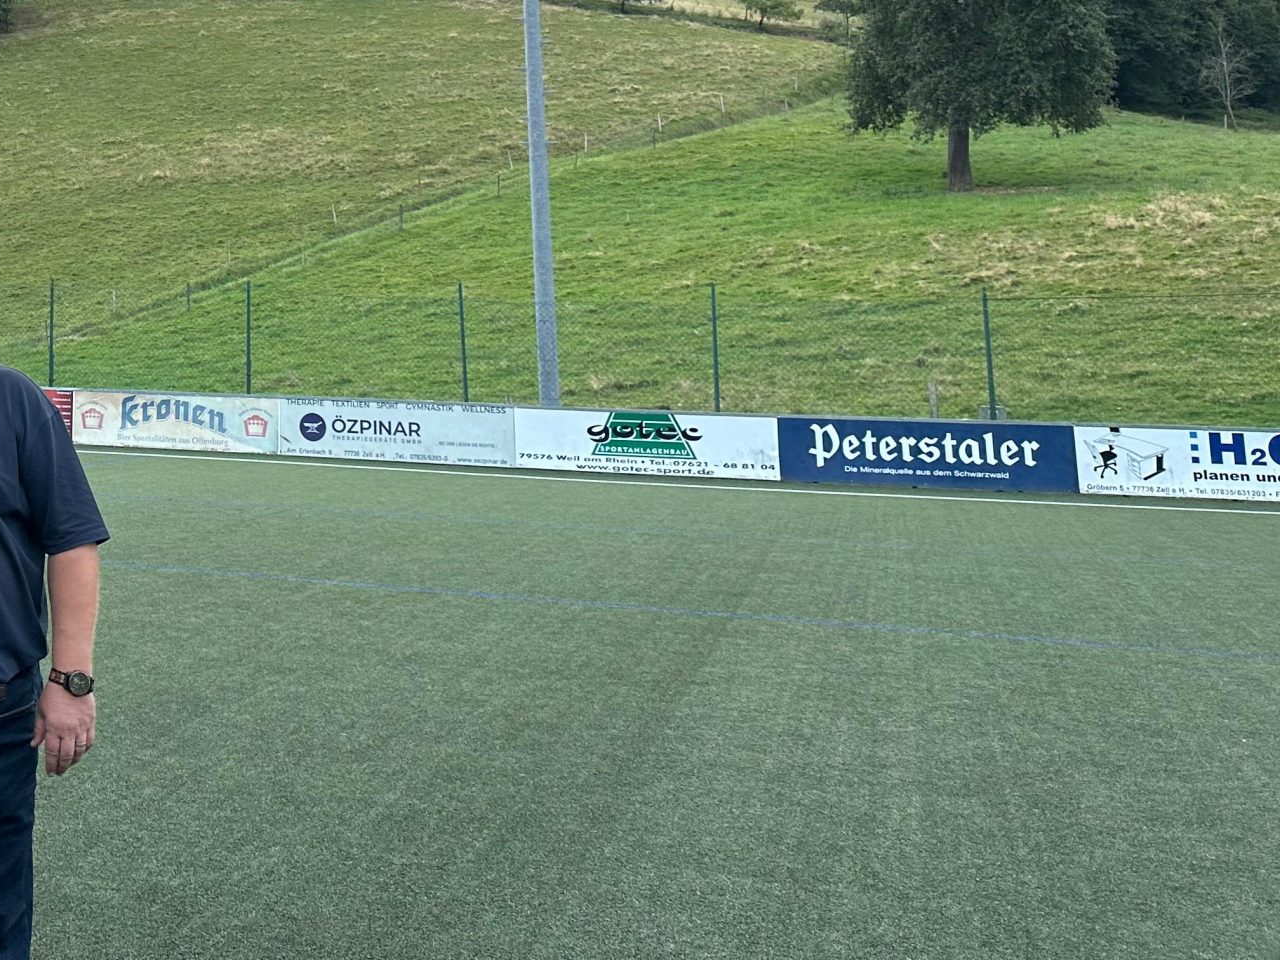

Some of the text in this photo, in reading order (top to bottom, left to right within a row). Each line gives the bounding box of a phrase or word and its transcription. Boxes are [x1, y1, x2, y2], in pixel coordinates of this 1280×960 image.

[286, 399, 325, 407] THERAPIE
[331, 400, 370, 408] TEXTILIEN
[405, 403, 454, 412] GYMNASTIK
[462, 405, 507, 414] WELLNESS
[331, 414, 421, 437] ÖZPINAR
[587, 420, 703, 443] gotec
[600, 445, 687, 455] SPORTANLAGENBAU
[808, 423, 1041, 468] Peterstaler
[576, 464, 715, 476] www.gotec-sport.de
[844, 465, 858, 473] Die
[859, 466, 914, 475] Mineralquelle
[933, 469, 952, 477] dem
[954, 469, 1010, 479] Schwarzwald
[1193, 470, 1250, 482] planen
[1086, 483, 1118, 492] Gröbern
